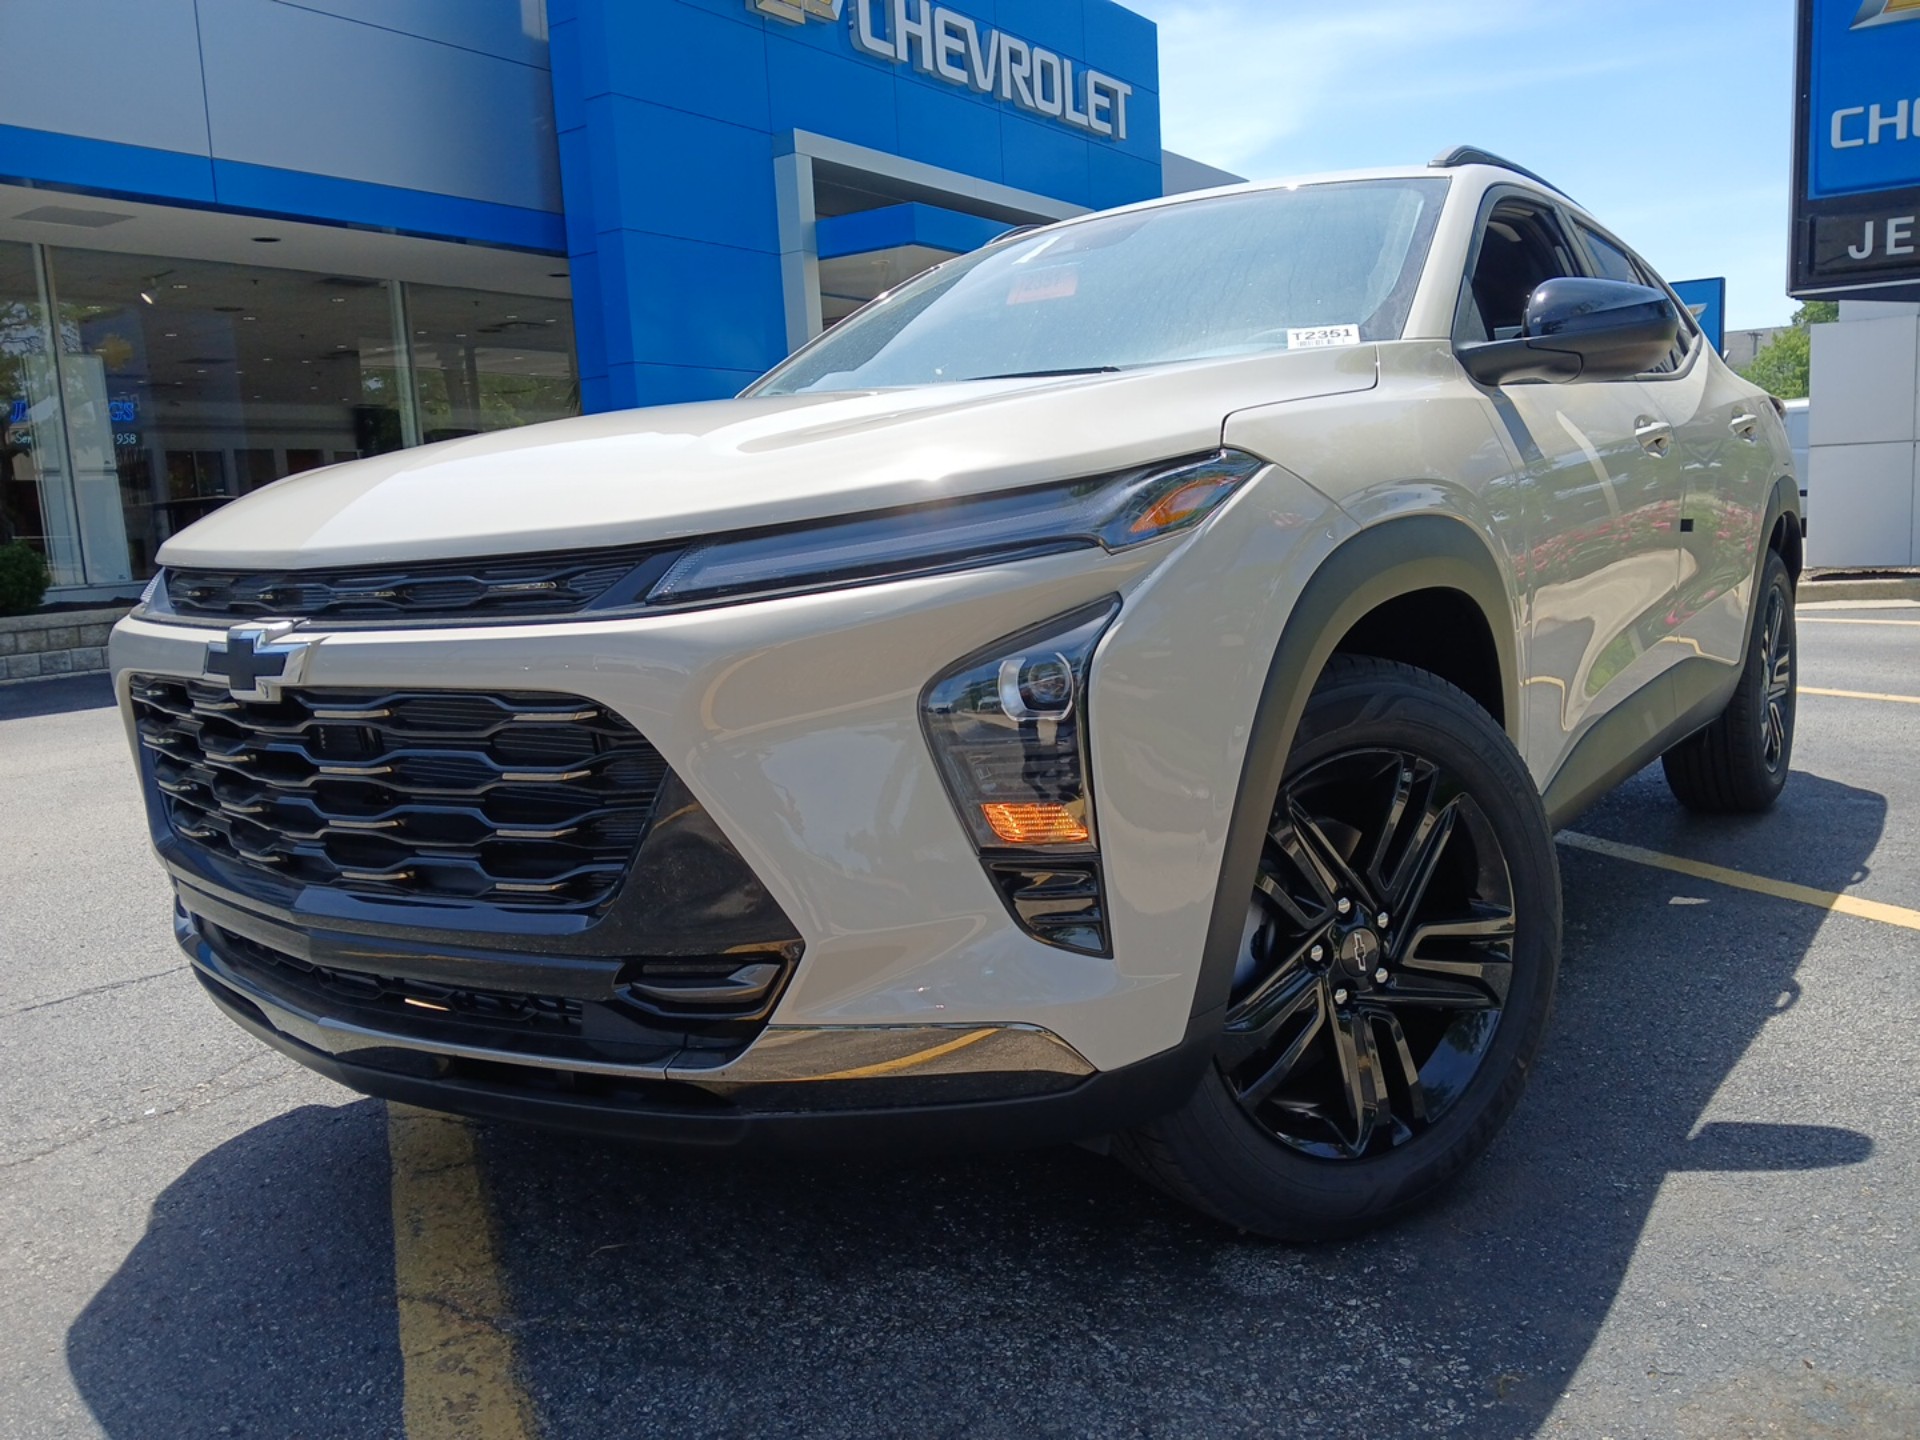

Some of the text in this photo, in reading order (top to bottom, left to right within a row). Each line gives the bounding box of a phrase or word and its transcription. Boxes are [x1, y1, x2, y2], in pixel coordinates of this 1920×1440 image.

[850, 0, 1132, 140] CHEVROLET
[1830, 97, 1920, 149] CH
[1847, 216, 1916, 260] JE
